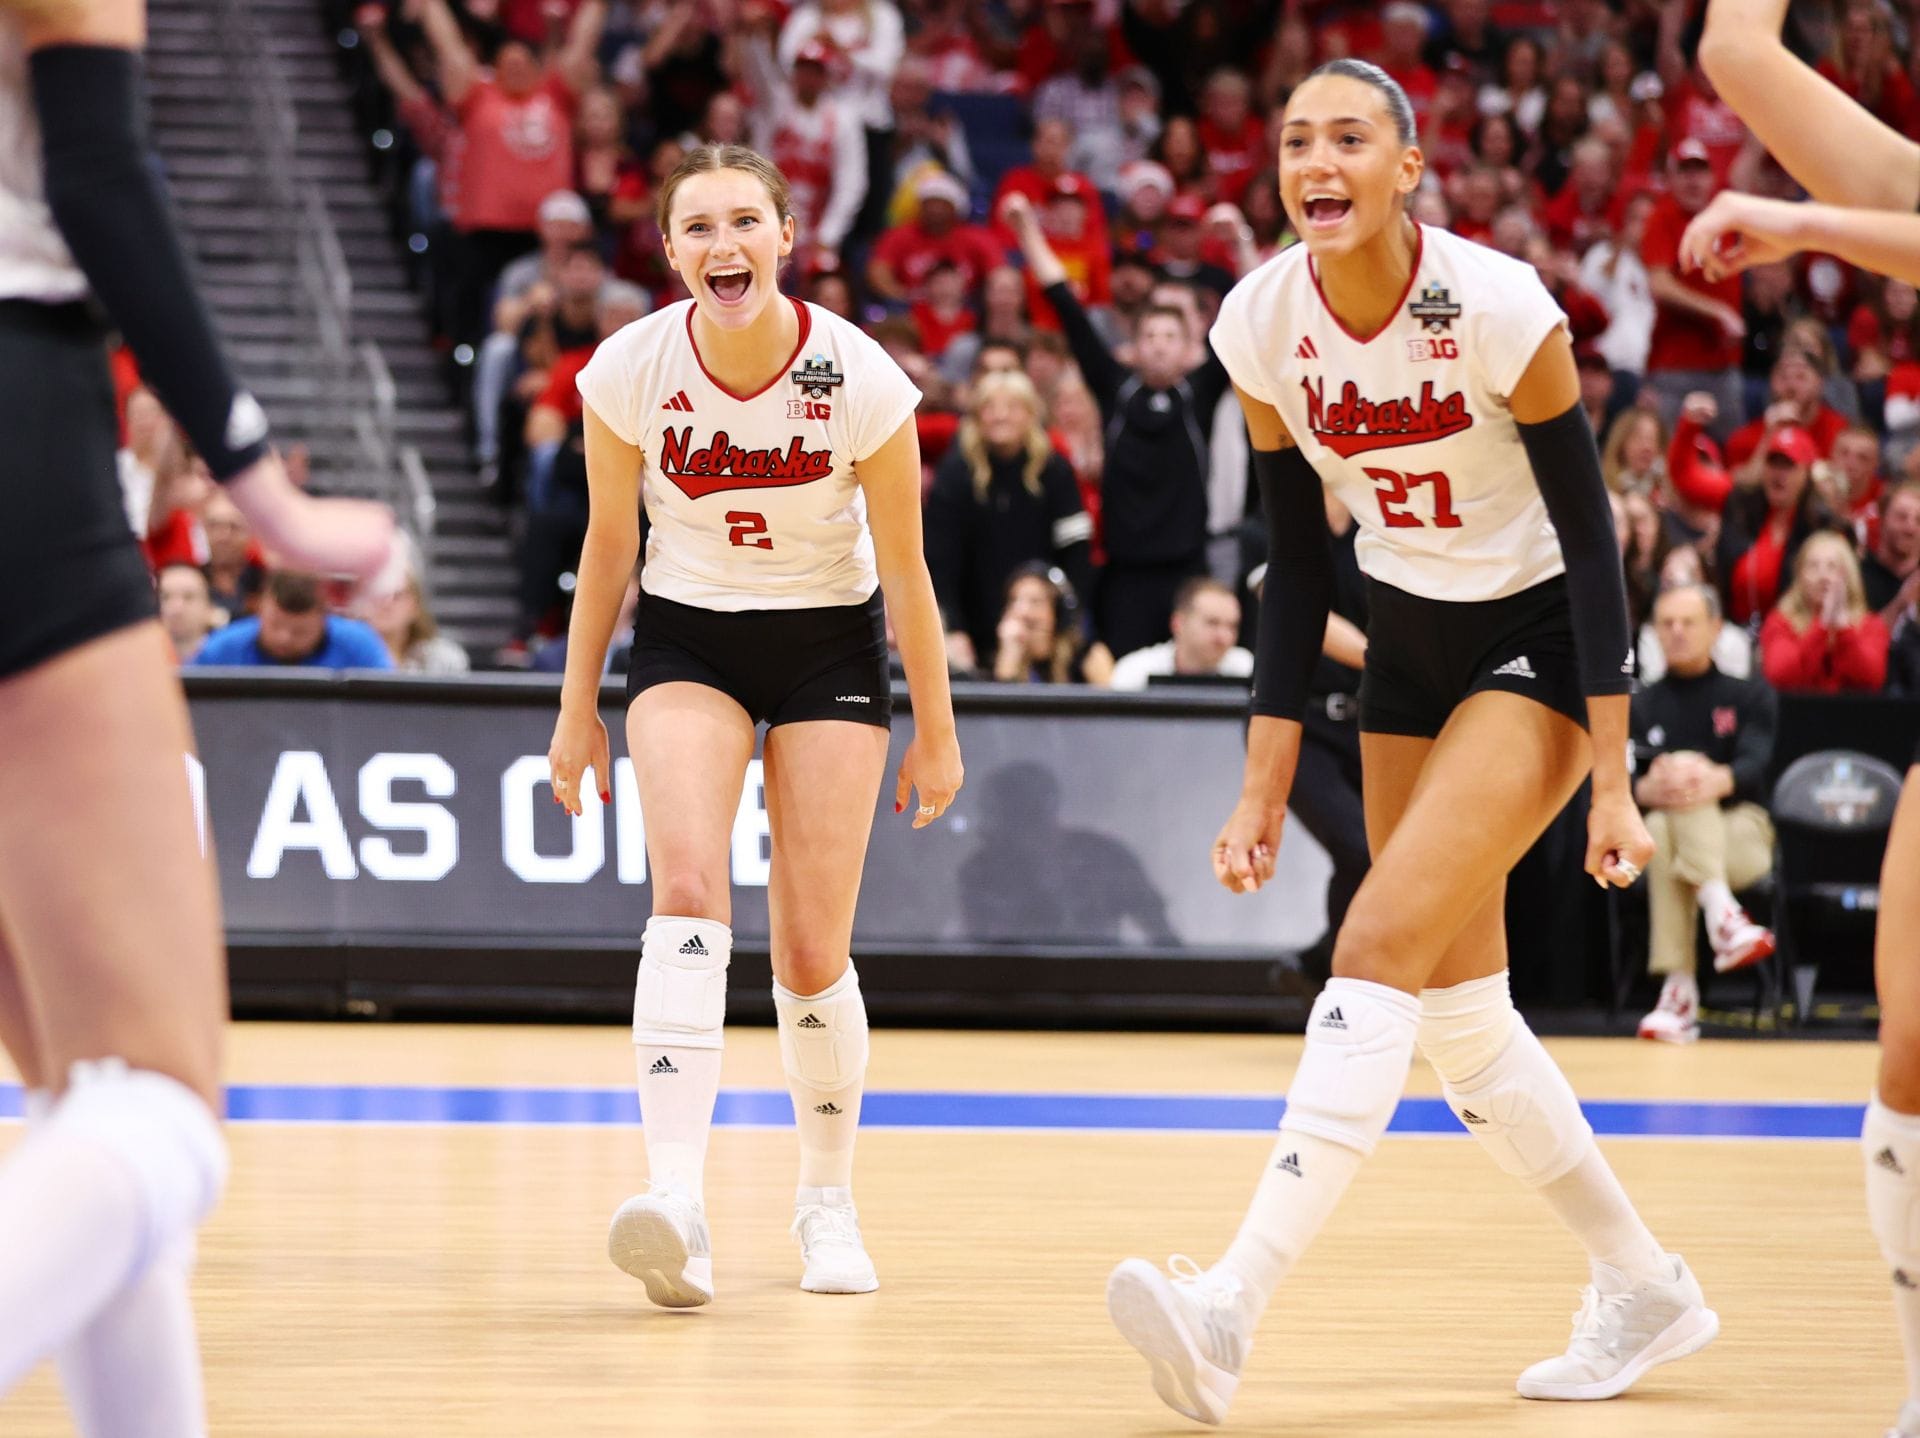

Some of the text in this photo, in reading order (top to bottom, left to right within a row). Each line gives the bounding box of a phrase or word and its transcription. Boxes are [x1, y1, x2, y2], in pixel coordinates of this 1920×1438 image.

[795, 374, 842, 384] CHAMPIONSHIP
[1300, 375, 1473, 437] Nebraska
[660, 426, 833, 480] Nebraska
[1361, 467, 1463, 528] 27
[724, 510, 774, 550] 2
[246, 751, 459, 881] AS
[679, 946, 709, 956] adidas
